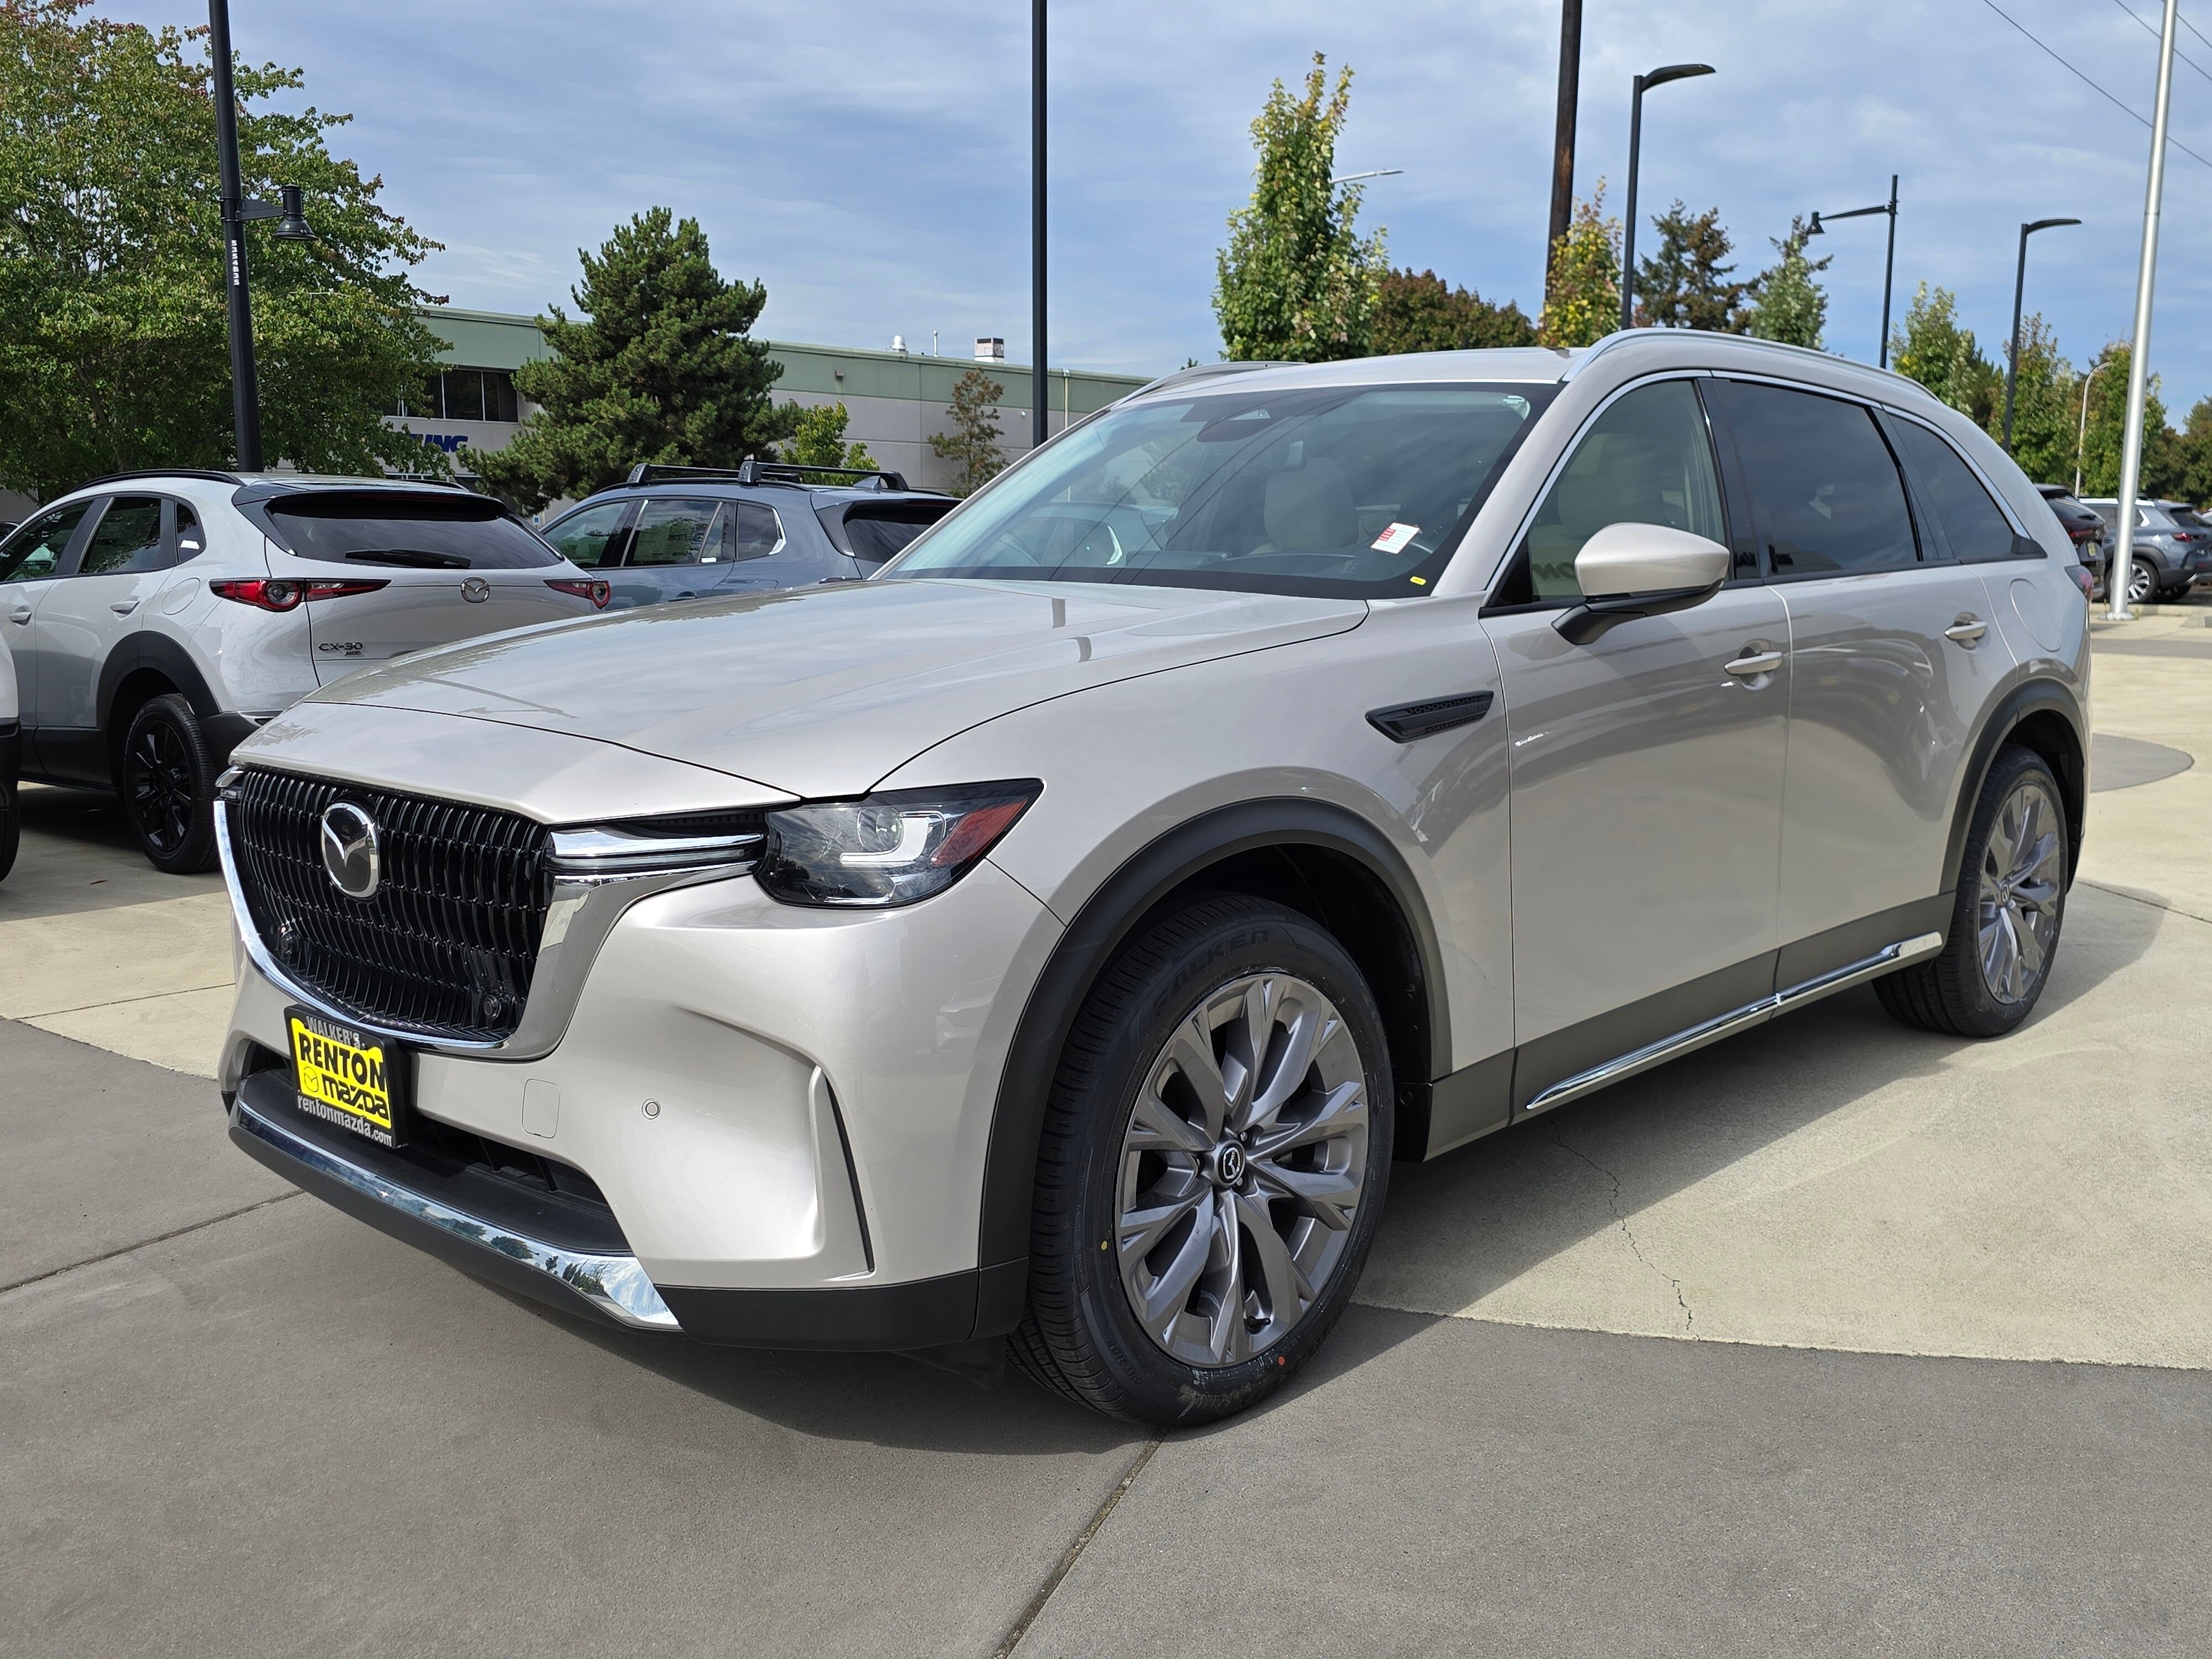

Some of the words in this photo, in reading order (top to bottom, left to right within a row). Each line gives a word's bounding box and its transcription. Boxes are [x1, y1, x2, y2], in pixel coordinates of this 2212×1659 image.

[405, 433, 468, 452] ING
[318, 641, 363, 651] CX-30
[306, 1016, 361, 1050] WALKER'S
[298, 1032, 386, 1093] RENTON
[297, 1095, 393, 1147] rentonmazda.com
